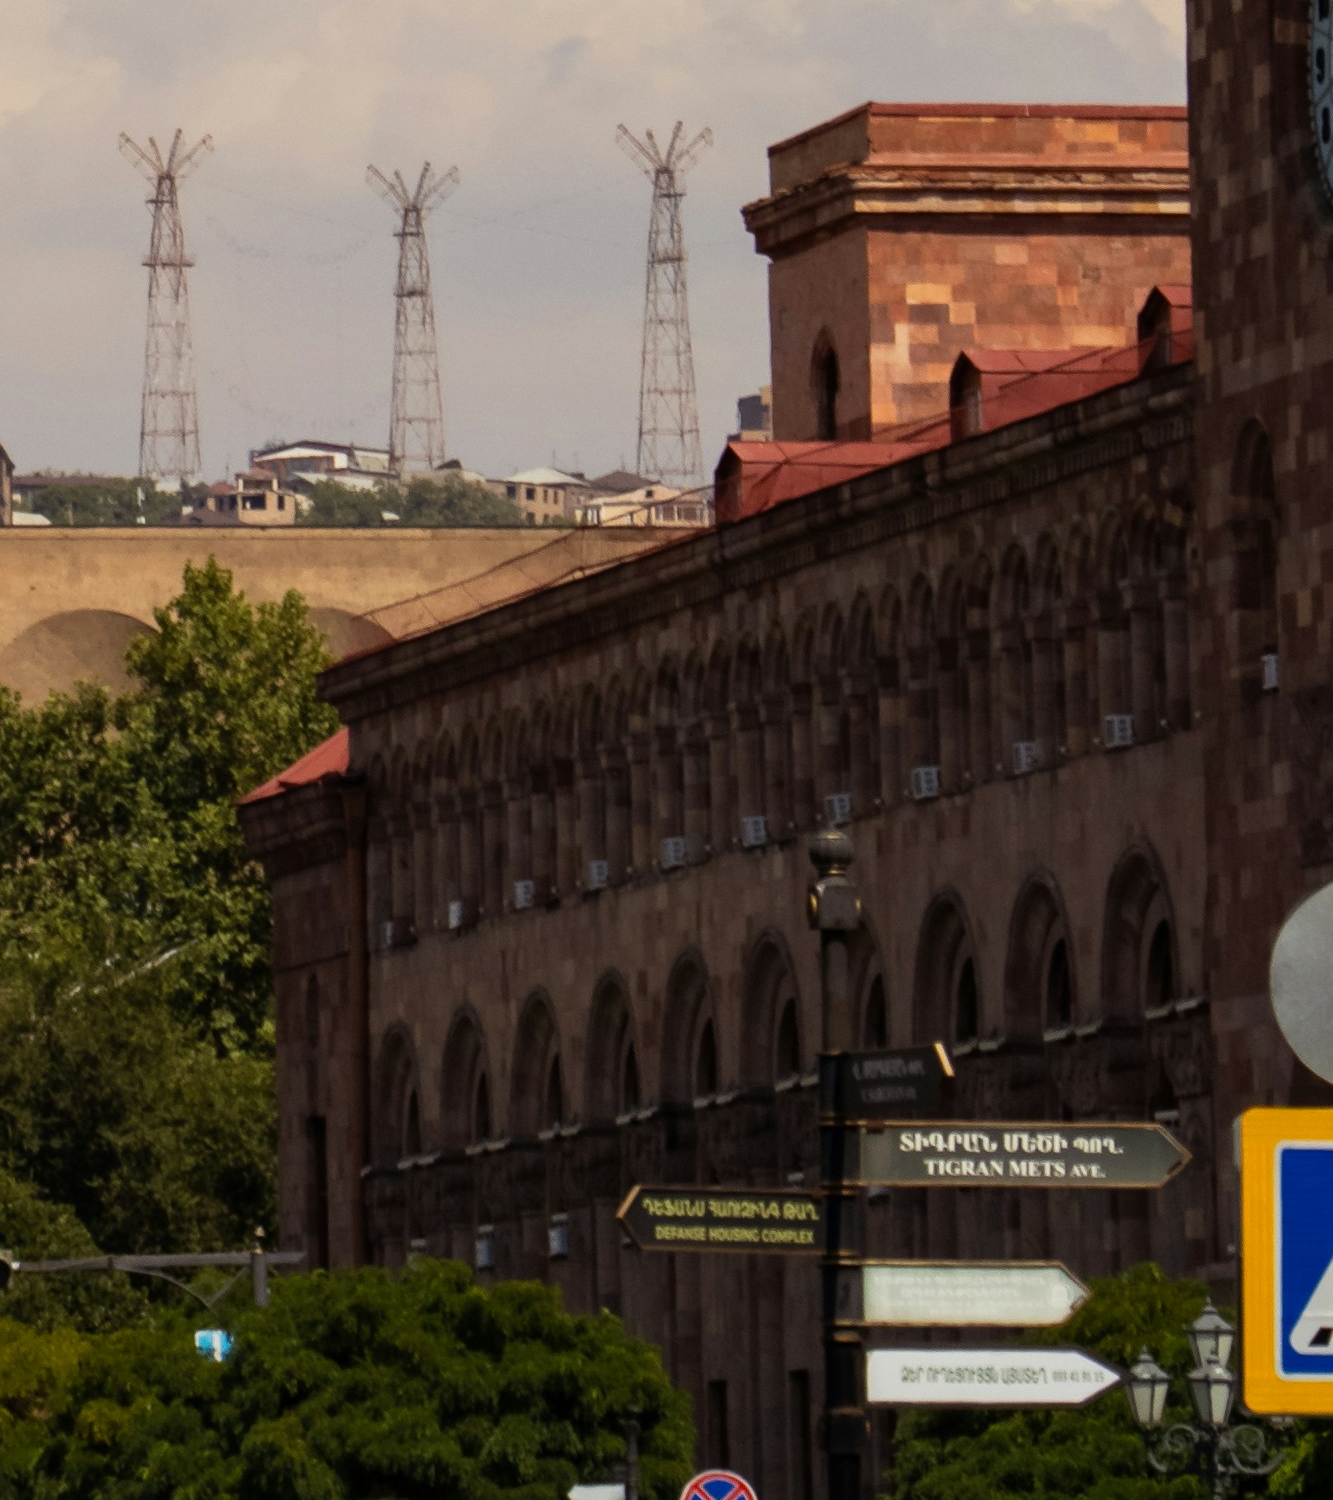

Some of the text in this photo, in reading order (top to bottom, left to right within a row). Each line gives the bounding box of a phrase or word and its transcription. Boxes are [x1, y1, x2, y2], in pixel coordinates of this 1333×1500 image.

[899, 1132, 998, 1154] ՏԻԳՐԱՆ
[1003, 1132, 1067, 1153] ՄԵԾԻ
[924, 1159, 1004, 1177] TIGRAN
[1009, 1160, 1066, 1178] METS
[708, 1227, 760, 1242] HOUSING
[761, 1228, 814, 1243] COMPLEX
